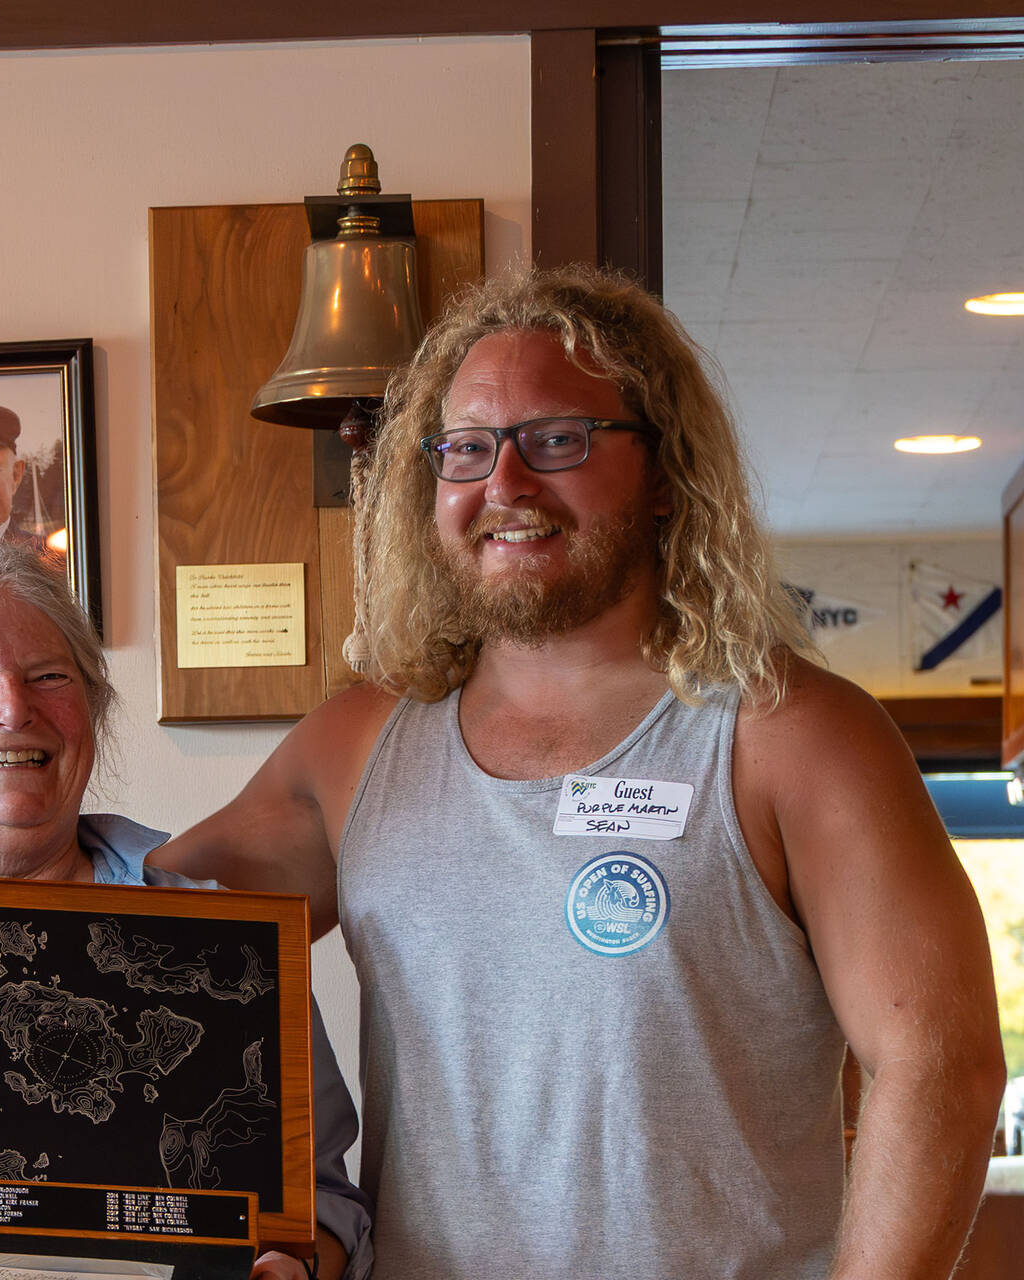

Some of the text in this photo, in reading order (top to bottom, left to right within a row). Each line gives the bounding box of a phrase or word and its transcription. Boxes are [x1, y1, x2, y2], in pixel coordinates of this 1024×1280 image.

[614, 780, 654, 801] Guest
[577, 802, 679, 816] PURPLE MARTIN
[586, 819, 631, 832] SEAN
[576, 863, 657, 923] US OPEN OF SURFING
[606, 922, 631, 934] WSL
